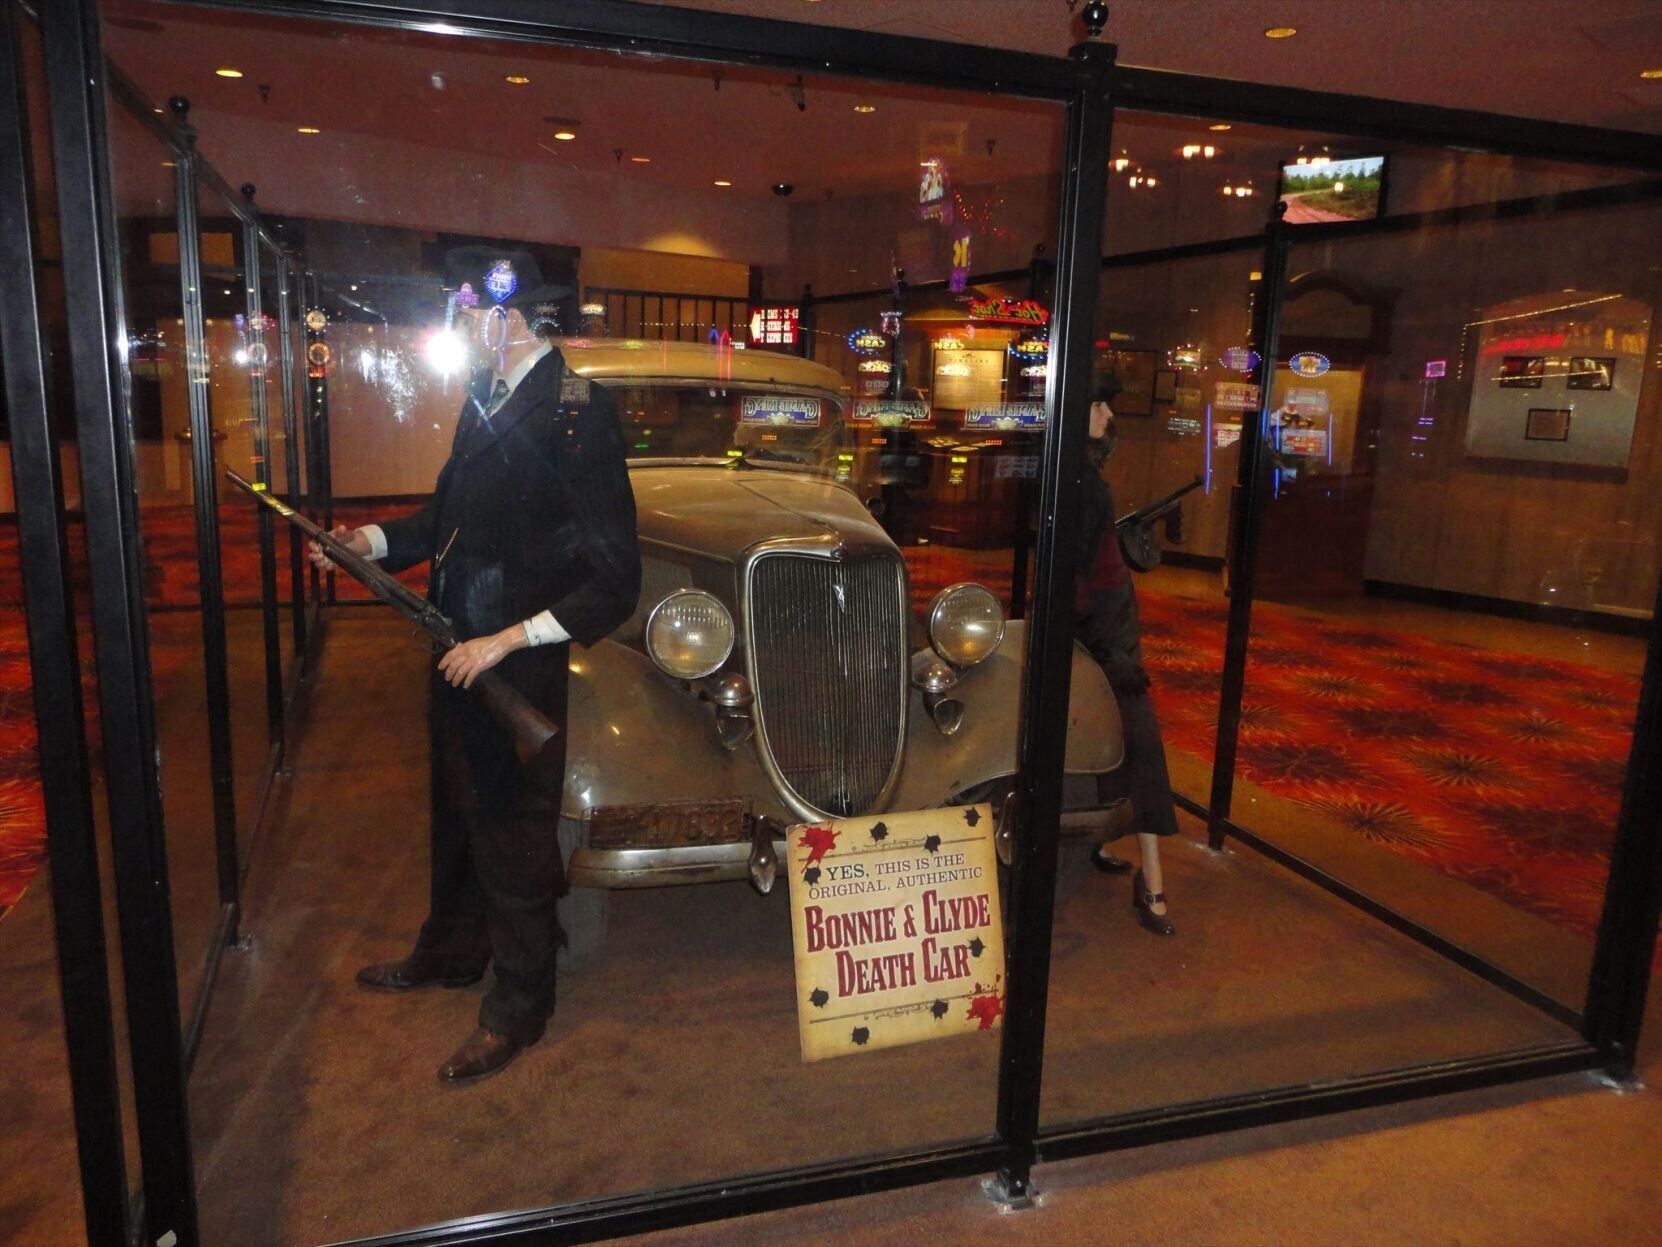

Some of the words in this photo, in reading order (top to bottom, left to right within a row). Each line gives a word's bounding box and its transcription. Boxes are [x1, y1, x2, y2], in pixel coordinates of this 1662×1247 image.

[826, 863, 870, 882] YES,
[875, 858, 911, 876] THIS
[916, 858, 930, 870] IS
[934, 853, 965, 868] THE
[896, 866, 982, 889] AUTHENTIC
[804, 904, 897, 953] BONNIE
[903, 904, 917, 938] &
[921, 889, 991, 935] CLYDE
[835, 950, 917, 998] DEATH
[921, 937, 971, 983] CAR
